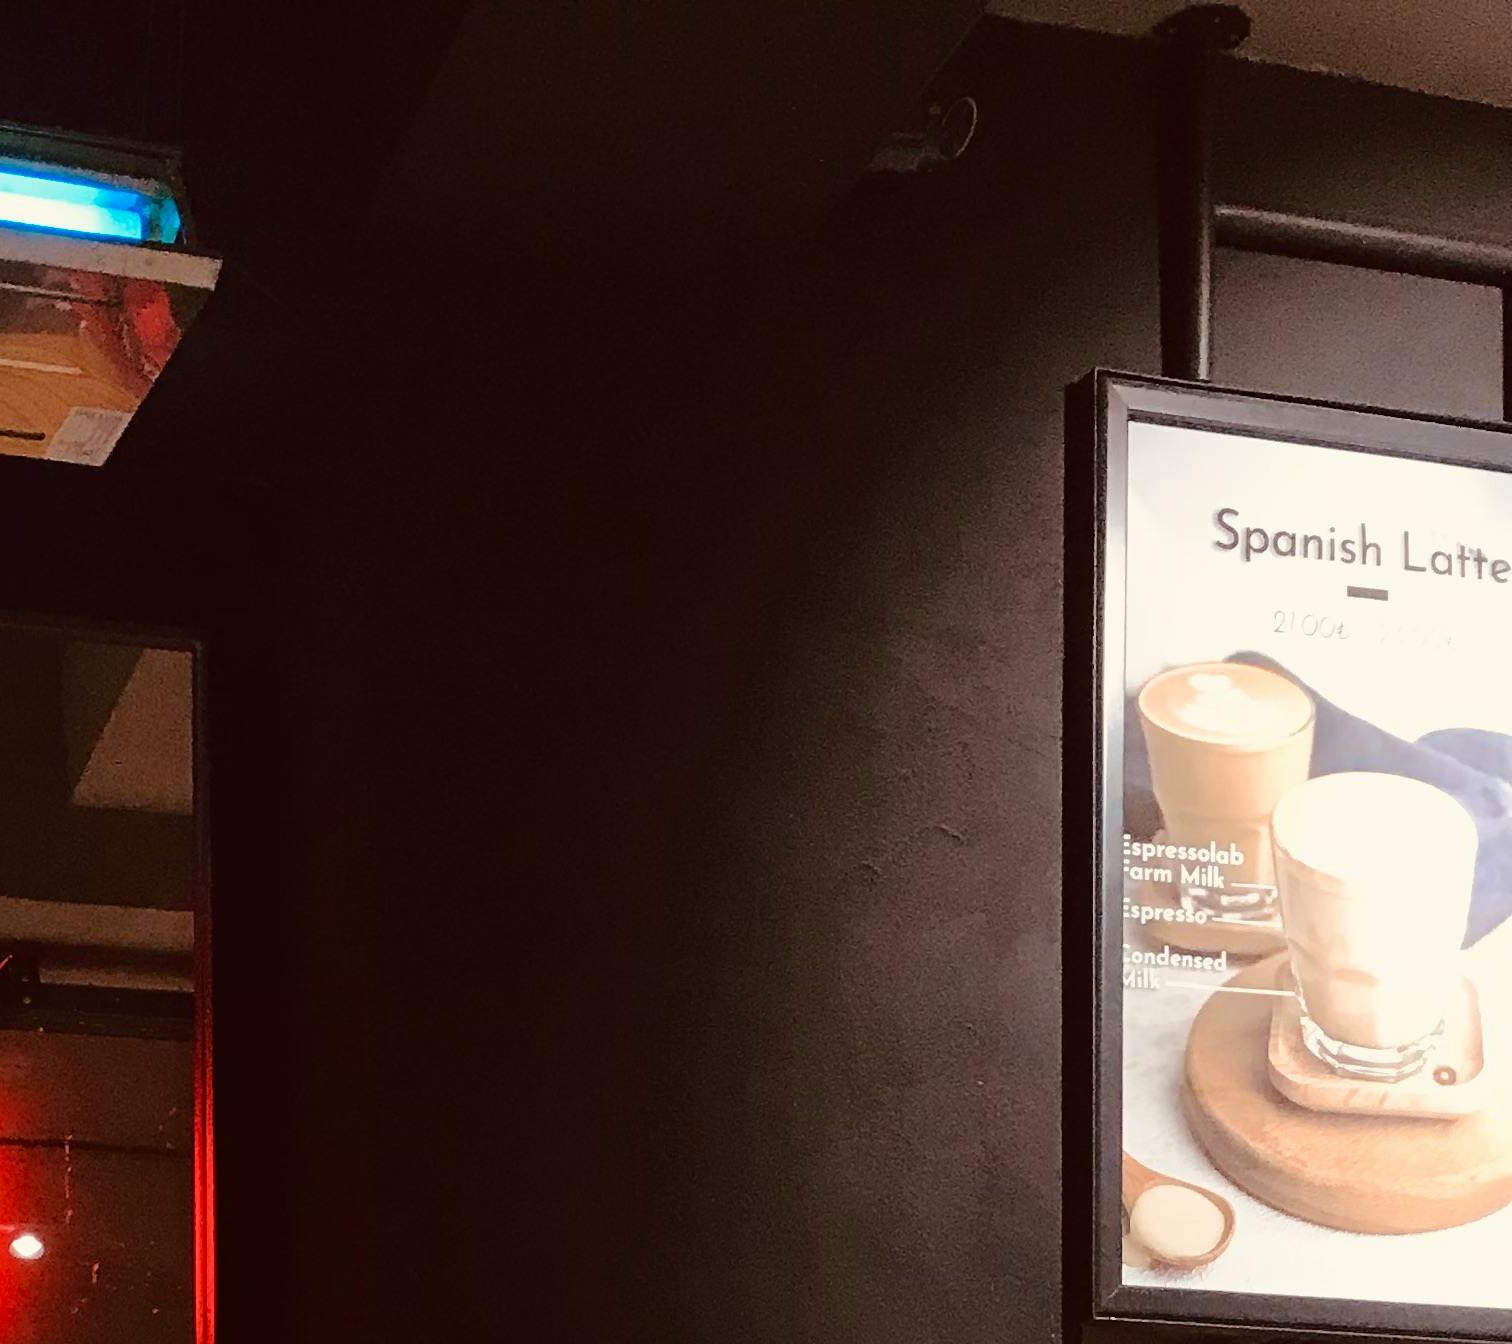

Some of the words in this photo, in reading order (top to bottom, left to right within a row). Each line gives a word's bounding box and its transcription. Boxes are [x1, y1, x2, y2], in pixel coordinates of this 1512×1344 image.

[1214, 506, 1383, 567] Spanish
[1402, 529, 1512, 584] Latte
[1180, 863, 1225, 889] Milk
